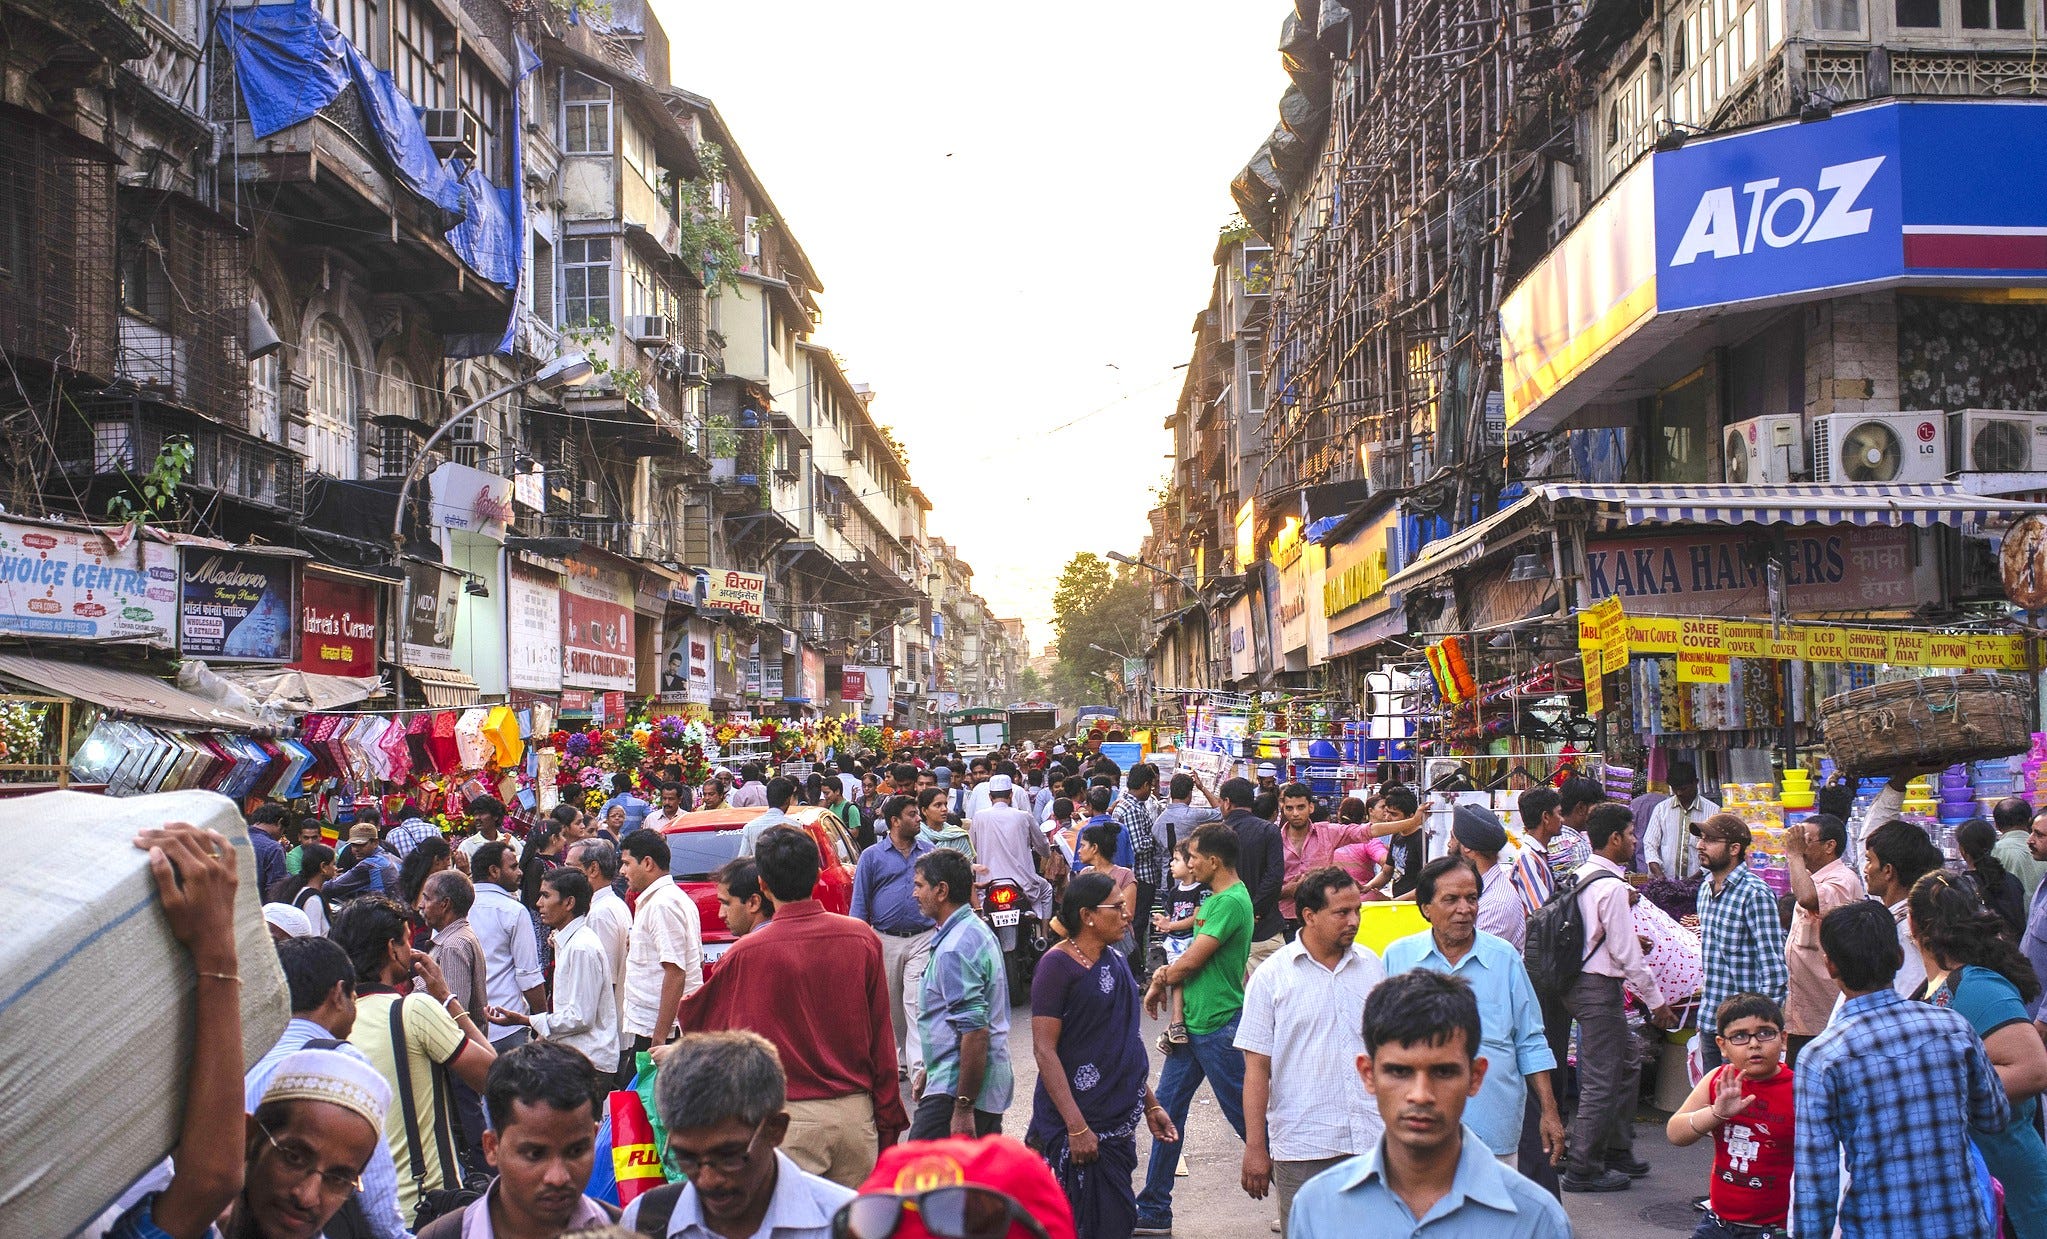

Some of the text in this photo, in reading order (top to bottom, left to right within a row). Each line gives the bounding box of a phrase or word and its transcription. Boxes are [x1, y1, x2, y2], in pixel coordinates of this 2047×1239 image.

[1750, 447, 1758, 458] LG
[1919, 445, 1934, 454] LG
[184, 555, 267, 589] Modern
[1587, 535, 1845, 599] KAKA HANERS
[0, 556, 149, 595] HOICE CENTRE
[725, 571, 764, 591] चिराग
[215, 587, 260, 603] Fancy Plastic
[44, 602, 59, 611] COVER
[186, 618, 222, 627] WHOLESALER
[342, 612, 375, 639] Corner
[1683, 622, 1719, 634] SAREE
[194, 627, 220, 635] RETAILER
[1650, 627, 1678, 643] COVER
[1724, 627, 1763, 639] COMPUTER
[1814, 632, 1835, 643] LCD
[1682, 635, 1721, 648] COVER
[1849, 633, 1886, 646] SHOWER
[1893, 636, 1923, 649] TABLE
[1975, 640, 1999, 651] T.V.
[1727, 641, 1757, 653] COVER
[1771, 643, 1798, 656] COVER
[1809, 645, 1844, 659] COVER
[1848, 646, 1887, 659] CURTAIN
[1931, 644, 1966, 659] APPRON
[1679, 651, 1730, 665] WASHING MACHINE
[1895, 650, 1919, 661] MAT
[1971, 654, 2006, 666] COVER
[1690, 664, 1716, 677] COVER
